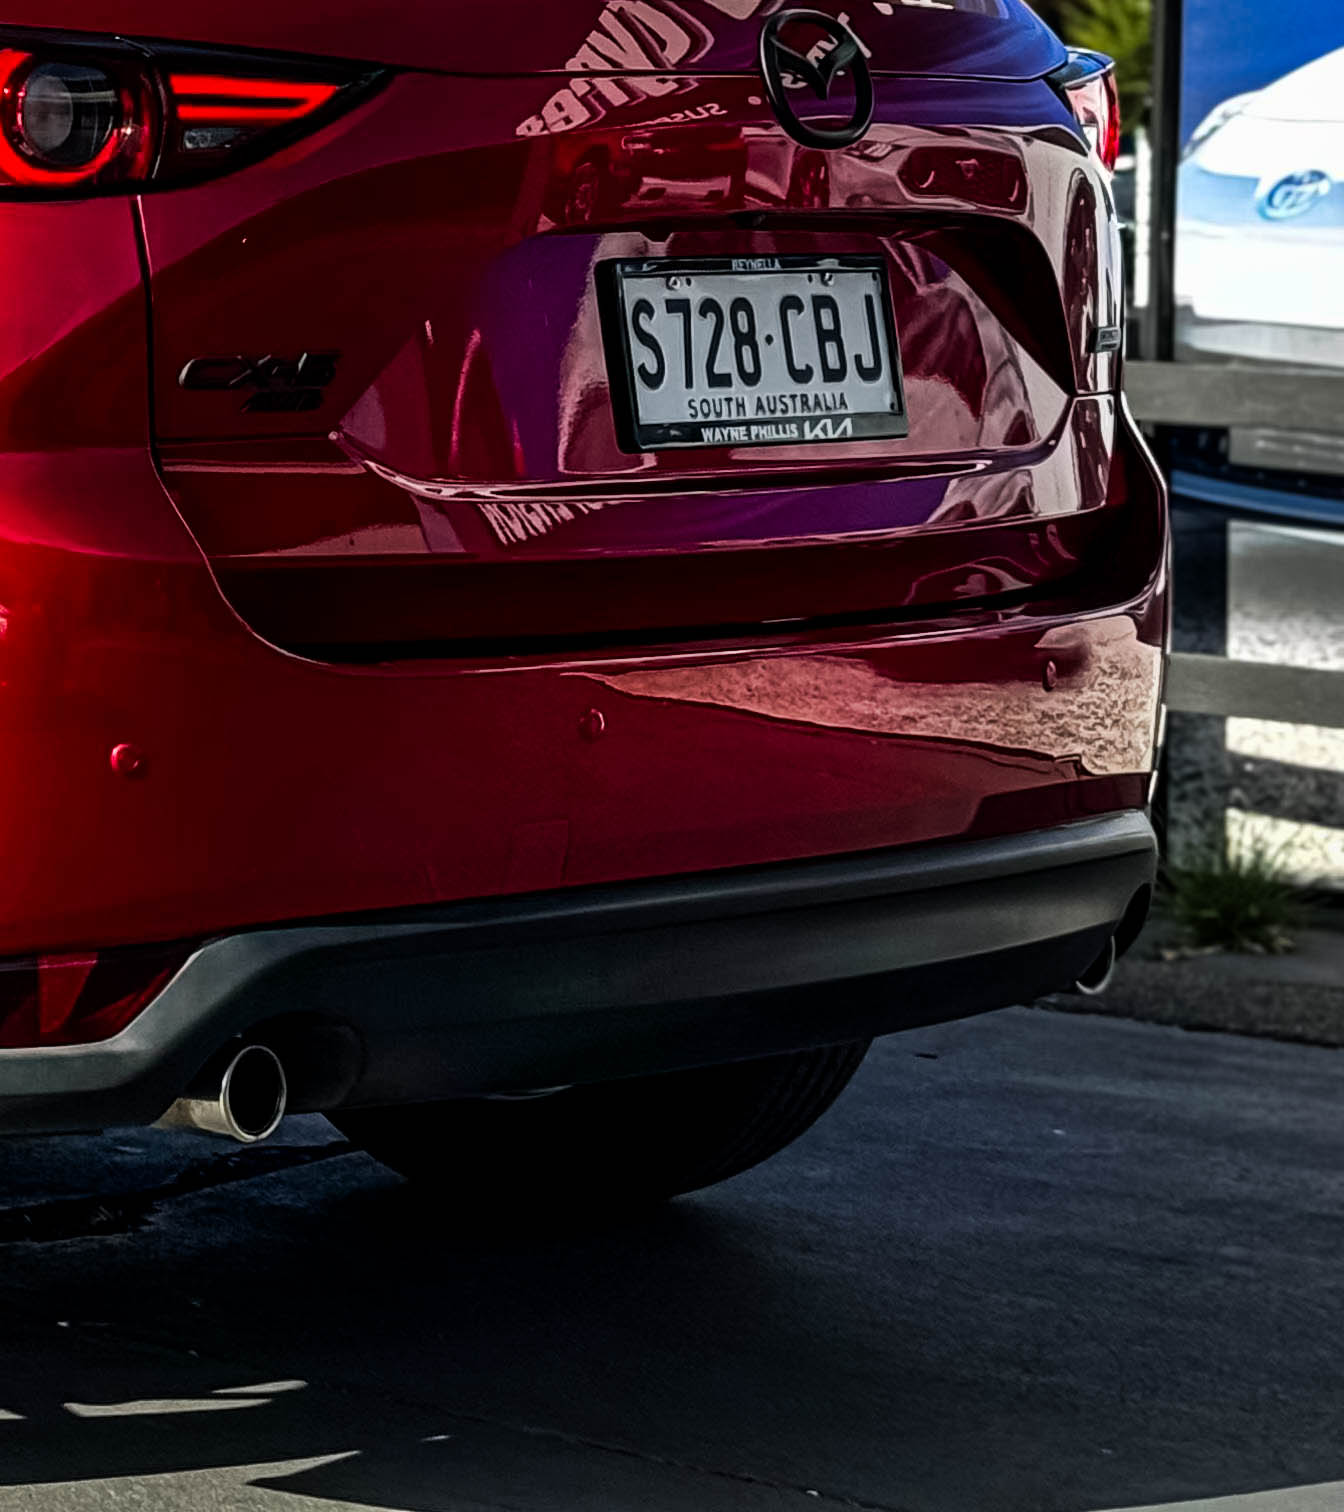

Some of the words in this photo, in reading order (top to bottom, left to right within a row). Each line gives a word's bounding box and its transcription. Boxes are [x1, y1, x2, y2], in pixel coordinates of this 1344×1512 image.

[731, 258, 782, 271] REYNELLA
[687, 396, 747, 419] SOUTH
[755, 392, 849, 415] AUSTRALIA
[701, 425, 748, 443] WAYNE
[750, 423, 799, 441] PHILLIS
